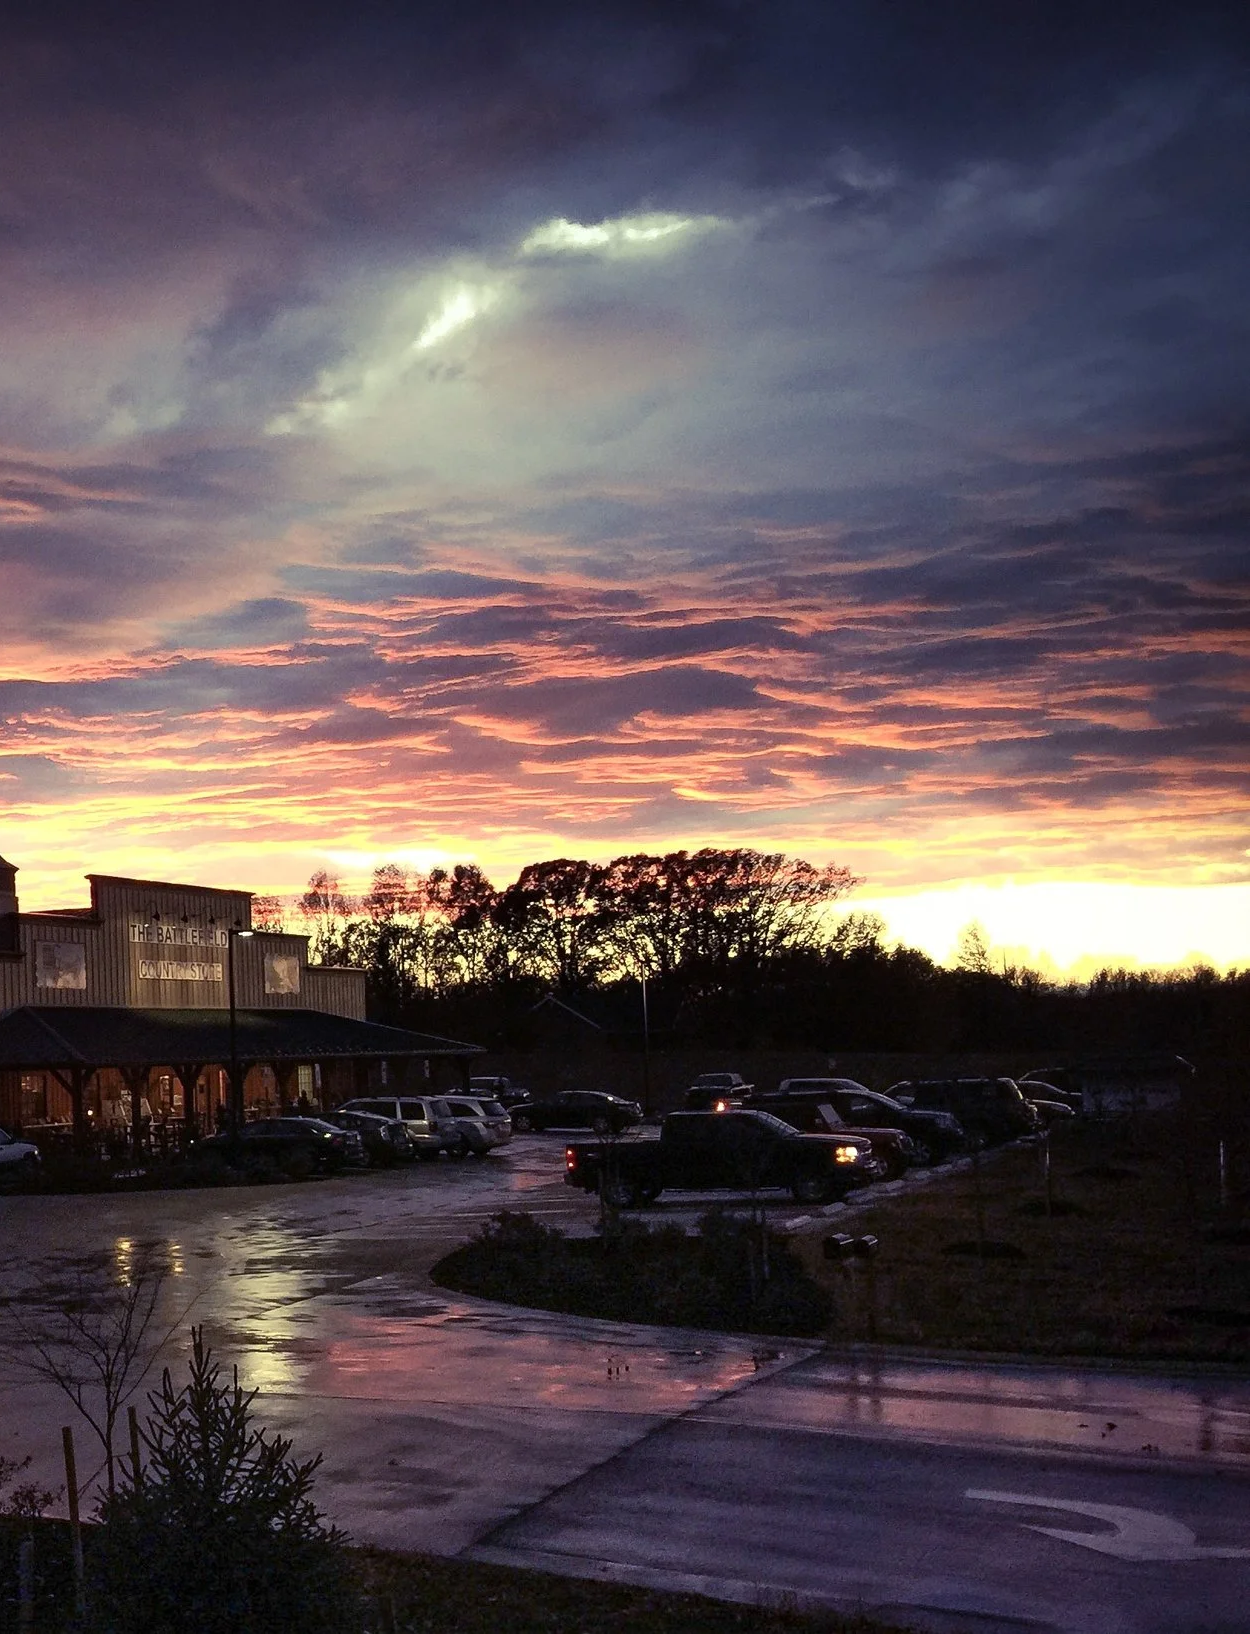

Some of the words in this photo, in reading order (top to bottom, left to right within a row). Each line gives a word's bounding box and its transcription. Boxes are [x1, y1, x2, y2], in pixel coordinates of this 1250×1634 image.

[130, 924, 153, 942] THE
[140, 960, 187, 979] COUNTRY
[190, 963, 222, 980] STORE
